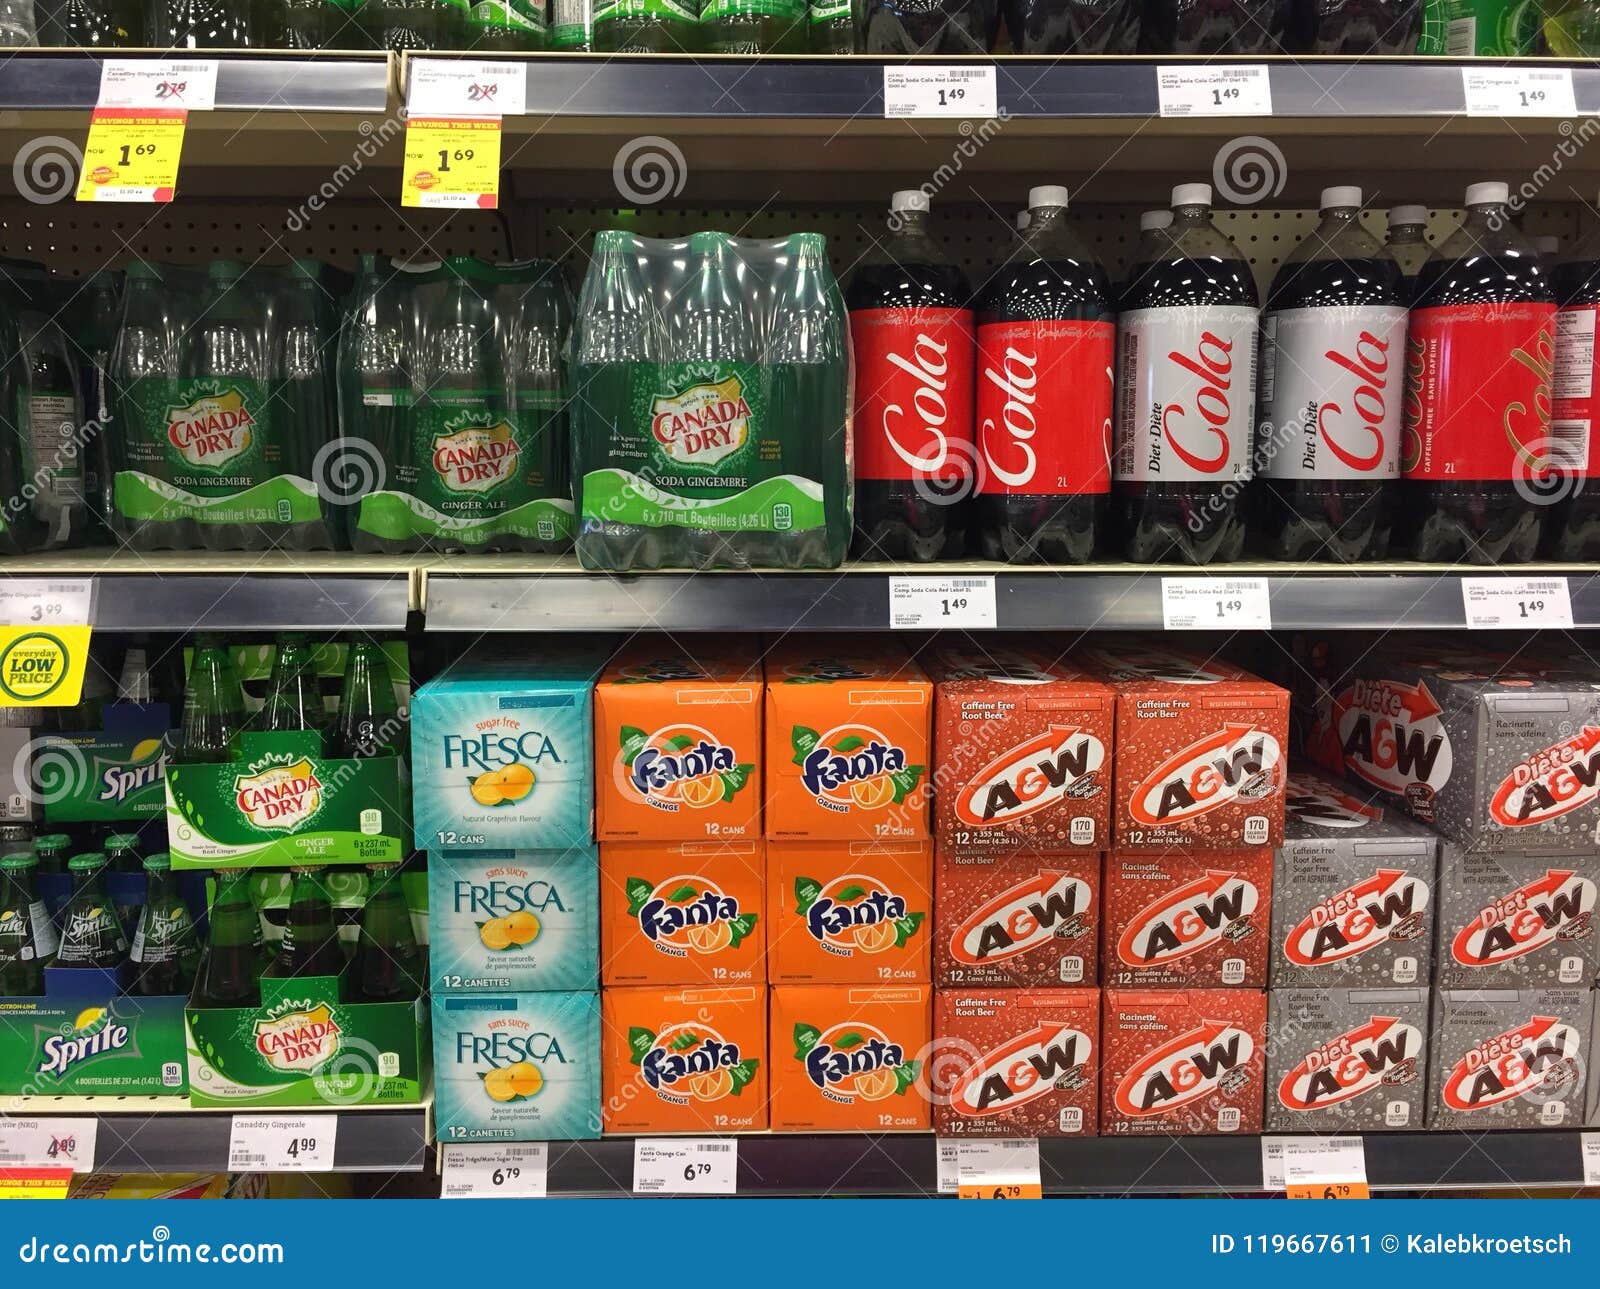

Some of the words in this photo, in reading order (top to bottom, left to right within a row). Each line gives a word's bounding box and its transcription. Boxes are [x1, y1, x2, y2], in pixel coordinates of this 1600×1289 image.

[883, 333, 948, 473] Cola
[1163, 331, 1233, 474] Cola
[1318, 330, 1390, 472] Cola
[652, 398, 752, 445] CANADA
[982, 346, 1038, 487] Cola
[168, 406, 256, 449] CANADA
[195, 431, 237, 458] DRY
[684, 423, 735, 456] DRY
[432, 438, 522, 474] CANADA
[457, 459, 503, 484] DRY
[655, 475, 685, 487] SODA
[687, 476, 748, 488] GINGEMBRE
[441, 500, 482, 510] GINGER
[486, 500, 507, 509] ALE
[773, 505, 790, 516] 130
[13, 649, 57, 659] everyday
[10, 658, 56, 672] LOW
[9, 672, 54, 686] PRICE
[961, 701, 996, 710] Caffeine
[997, 701, 1015, 710] Free
[1136, 700, 1171, 709] Caffeine
[1172, 700, 1190, 708] Free
[961, 711, 982, 720] Root
[984, 711, 1003, 720] Beer
[1137, 710, 1158, 719] Root
[1160, 710, 1179, 718] Beer
[443, 731, 562, 772] FRESCA
[1343, 713, 1445, 783] A&W
[631, 741, 735, 794] Fanta
[802, 741, 907, 794] Fanta
[1512, 745, 1575, 787] Diète
[982, 738, 1090, 823] A&W
[1156, 736, 1265, 821] A&W
[236, 774, 322, 814] CANADA
[264, 795, 306, 821] DRY
[646, 796, 680, 812] ORANGE
[817, 797, 850, 813] ORANGE
[705, 822, 720, 835] 12
[722, 825, 746, 835] CANS
[875, 823, 889, 836] 12
[892, 826, 916, 836] CANS
[1074, 820, 1091, 831] 170
[1249, 819, 1265, 830] 170
[295, 838, 334, 847] GINGER
[437, 831, 457, 845] 12
[460, 834, 485, 844] CANS
[955, 831, 970, 845] 12
[305, 846, 324, 854] ALE
[359, 848, 387, 857] Bottles
[955, 856, 975, 865] Root
[977, 856, 995, 865] Beer
[1121, 862, 1160, 871] Racinette
[1293, 856, 1310, 864] Root
[485, 867, 506, 880] sans
[506, 867, 529, 879] sucre
[1141, 871, 1171, 880] caféine
[454, 880, 567, 919] FRESCA
[640, 891, 739, 941] Fanta
[808, 890, 907, 940] Fanta
[1310, 890, 1358, 928] Diet
[1479, 891, 1527, 929] Diet
[975, 881, 1077, 961] A&W
[1143, 883, 1245, 963] A&W
[1310, 881, 1416, 962] A&W
[1477, 882, 1584, 963] A&W
[655, 942, 688, 957] ORANGE
[821, 942, 853, 957] ORANGE
[485, 962, 493, 970] de
[494, 962, 537, 972] pamplemousse
[1064, 959, 1079, 969] 170
[1226, 961, 1241, 971] 170
[1402, 959, 1408, 970] 0
[1568, 959, 1575, 970] 0
[712, 967, 727, 979] 12
[729, 970, 752, 980] CANS
[877, 967, 892, 978] 12
[894, 970, 917, 979] CANS
[950, 970, 964, 982] 12
[1117, 972, 1132, 984] 12
[443, 975, 462, 988] 12
[464, 978, 511, 988] CANETTES
[955, 998, 988, 1007] Caffeine
[989, 998, 1006, 1007] Free
[955, 1008, 976, 1016] Root
[977, 1008, 995, 1016] Beer
[1119, 1012, 1157, 1021] Racinette
[1450, 1008, 1488, 1017] Racinette
[1119, 1023, 1138, 1031] sans
[1139, 1021, 1168, 1031] caféine
[256, 1018, 341, 1056] CANADA
[40, 1016, 129, 1075] Sprite
[283, 1039, 323, 1064] DRY
[456, 1031, 568, 1069] FRESCA
[1304, 1035, 1352, 1073] Diet
[1464, 1033, 1524, 1074] Diète
[641, 1039, 740, 1088] Fanta
[806, 1039, 903, 1088] Fanta
[1303, 1028, 1409, 1107] A&W
[1468, 1028, 1568, 1105] A&W
[165, 1066, 178, 1076] 90
[975, 1034, 1078, 1113] A&W
[1141, 1033, 1241, 1112] A&W
[656, 1091, 689, 1105] ORANGE
[822, 1090, 854, 1104] ORANGE
[1063, 1110, 1079, 1120] 170
[1222, 1110, 1237, 1120] 170
[1394, 1104, 1401, 1114] 0
[1550, 1105, 1556, 1114] 0
[271, 1120, 306, 1130] Gingerale
[489, 1113, 498, 1121] de
[499, 1114, 541, 1123] pamplemousse
[714, 1114, 728, 1126] 12
[730, 1117, 753, 1126] CANS
[878, 1114, 892, 1125] 12
[894, 1117, 917, 1126] CANS
[448, 1126, 467, 1138] 12
[469, 1129, 515, 1138] CANETTES
[950, 1121, 964, 1133] 12
